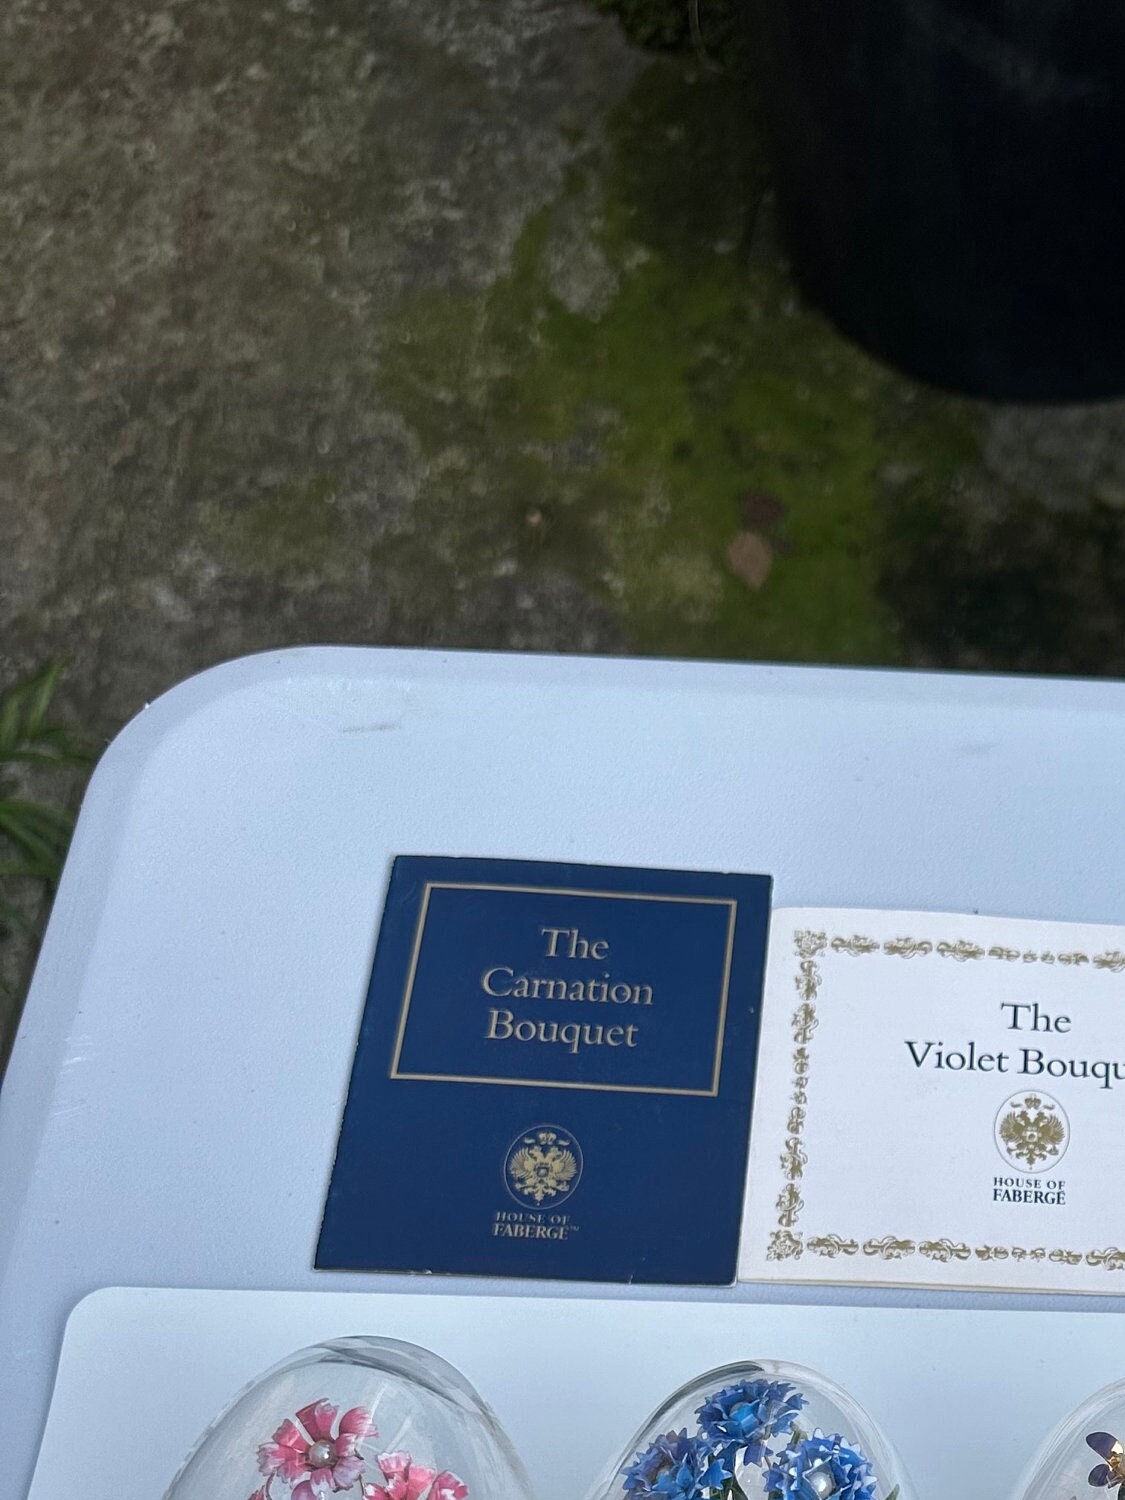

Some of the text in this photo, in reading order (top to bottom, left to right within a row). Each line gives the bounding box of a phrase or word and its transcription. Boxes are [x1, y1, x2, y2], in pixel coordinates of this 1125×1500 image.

[540, 927, 609, 961] The
[481, 967, 654, 1006] Carnation
[485, 1007, 638, 1053] Bouquet
[1000, 1002, 1072, 1034] The
[904, 1041, 1010, 1074] Violet
[993, 1176, 1066, 1190] HOUSE OF
[495, 1211, 570, 1225] HOUSE OF
